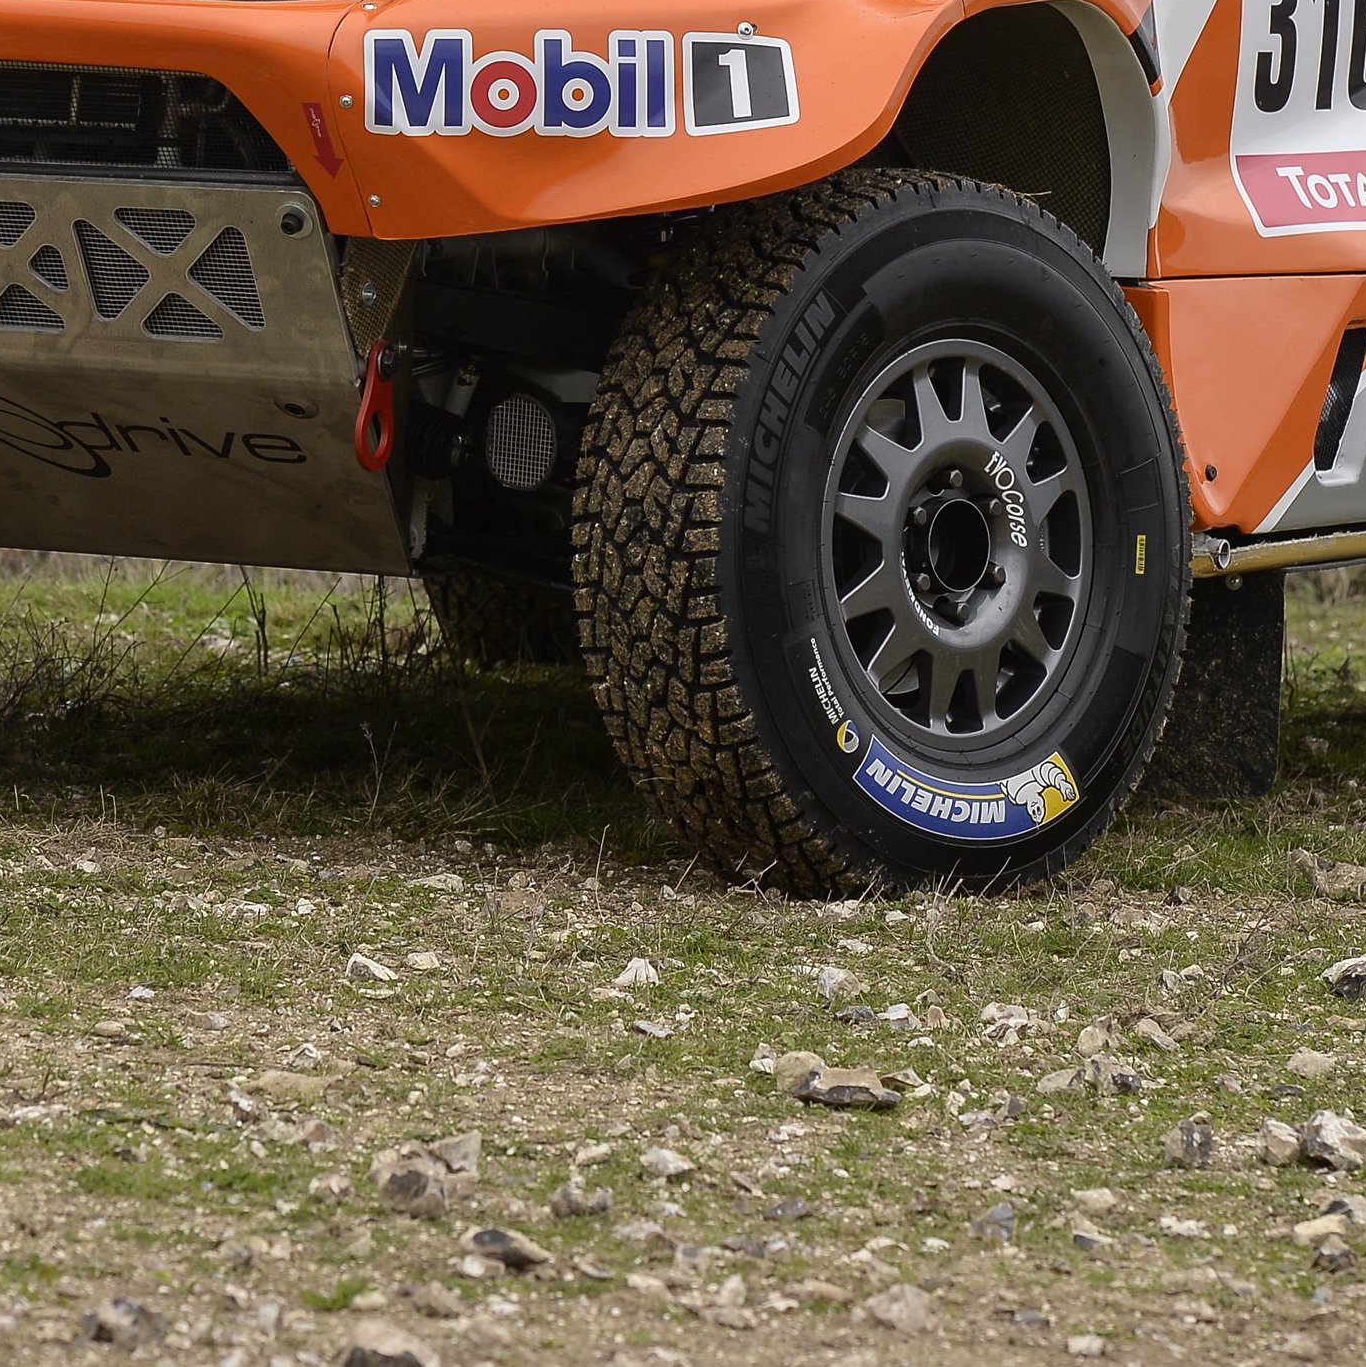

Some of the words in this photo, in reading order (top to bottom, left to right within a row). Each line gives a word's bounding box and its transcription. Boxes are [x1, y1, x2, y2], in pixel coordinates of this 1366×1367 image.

[374, 39, 667, 128] Mobil
[744, 290, 836, 532] MICHELIN
[809, 666, 840, 726] MICHELIN
[831, 696, 845, 719] Total
[865, 757, 1006, 824] MICHELIN
